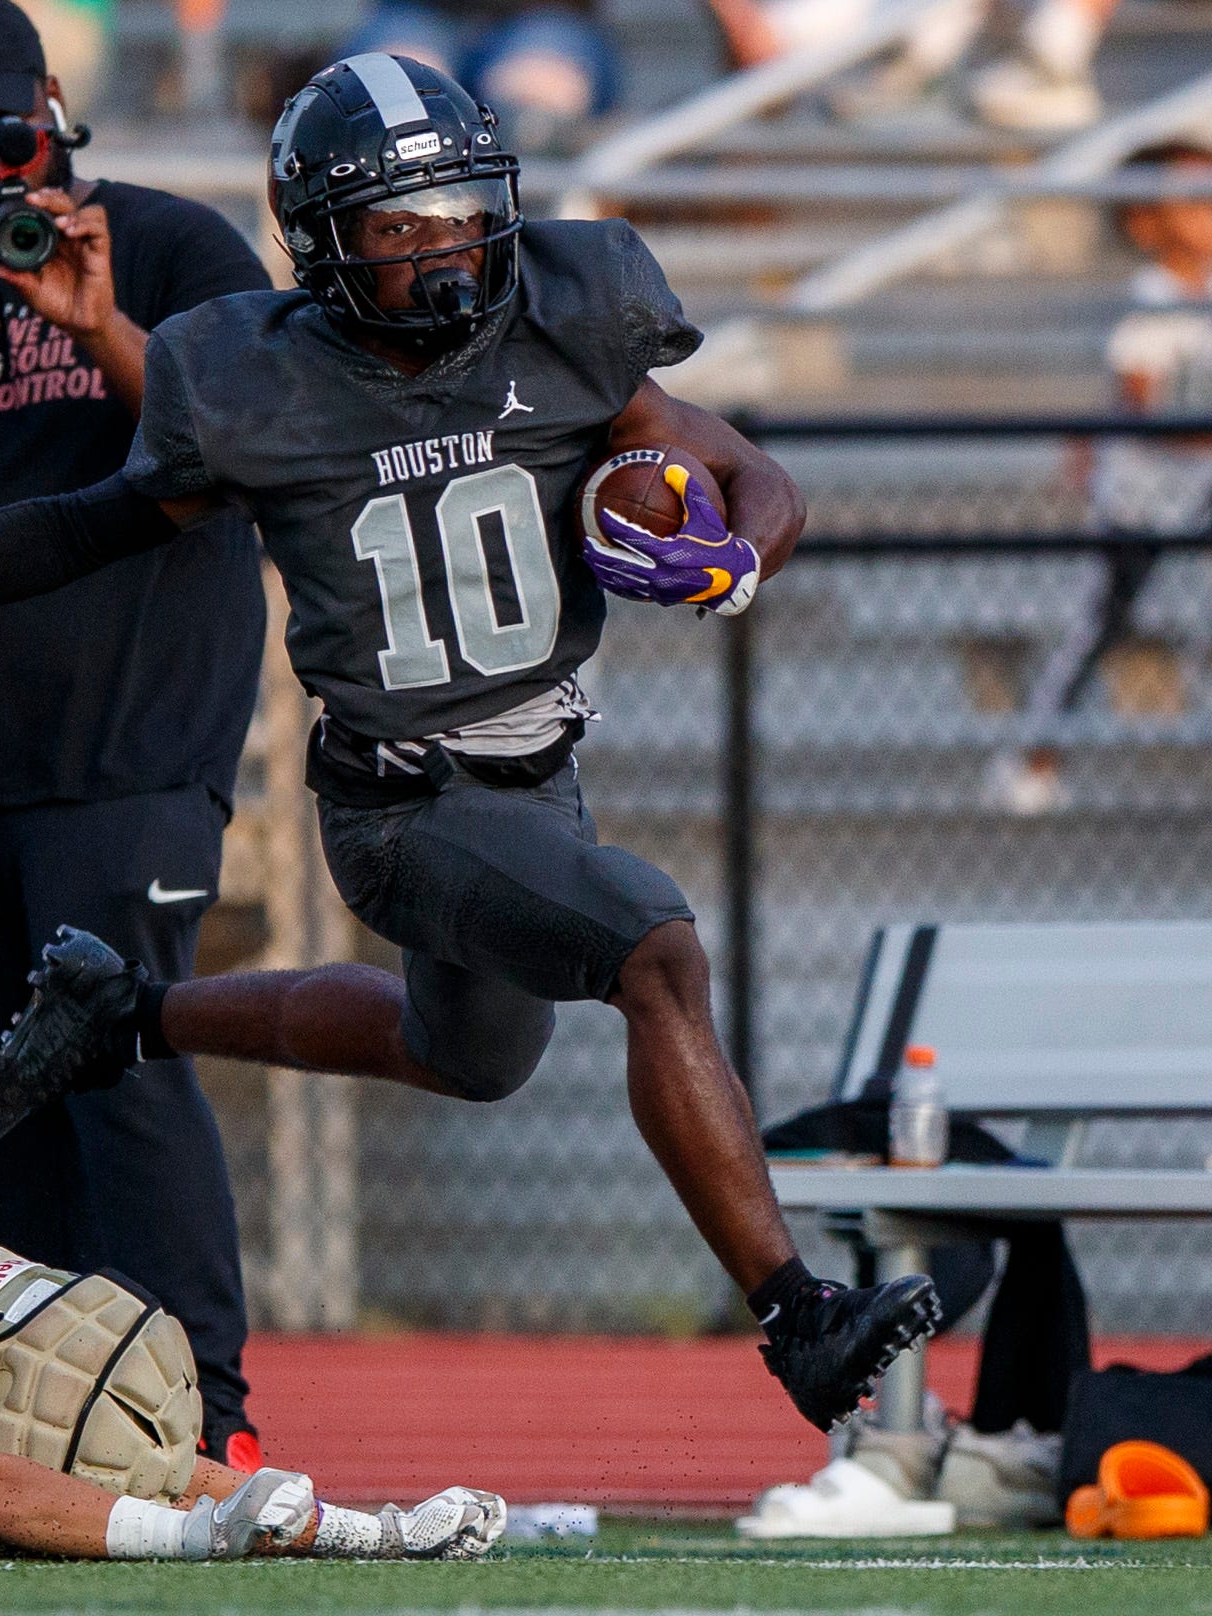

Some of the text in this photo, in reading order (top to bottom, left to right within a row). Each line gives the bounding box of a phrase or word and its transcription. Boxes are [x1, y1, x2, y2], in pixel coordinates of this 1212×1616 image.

[400, 139, 437, 154] schutt
[371, 430, 495, 486] HOUSTON
[350, 463, 561, 690] 10
